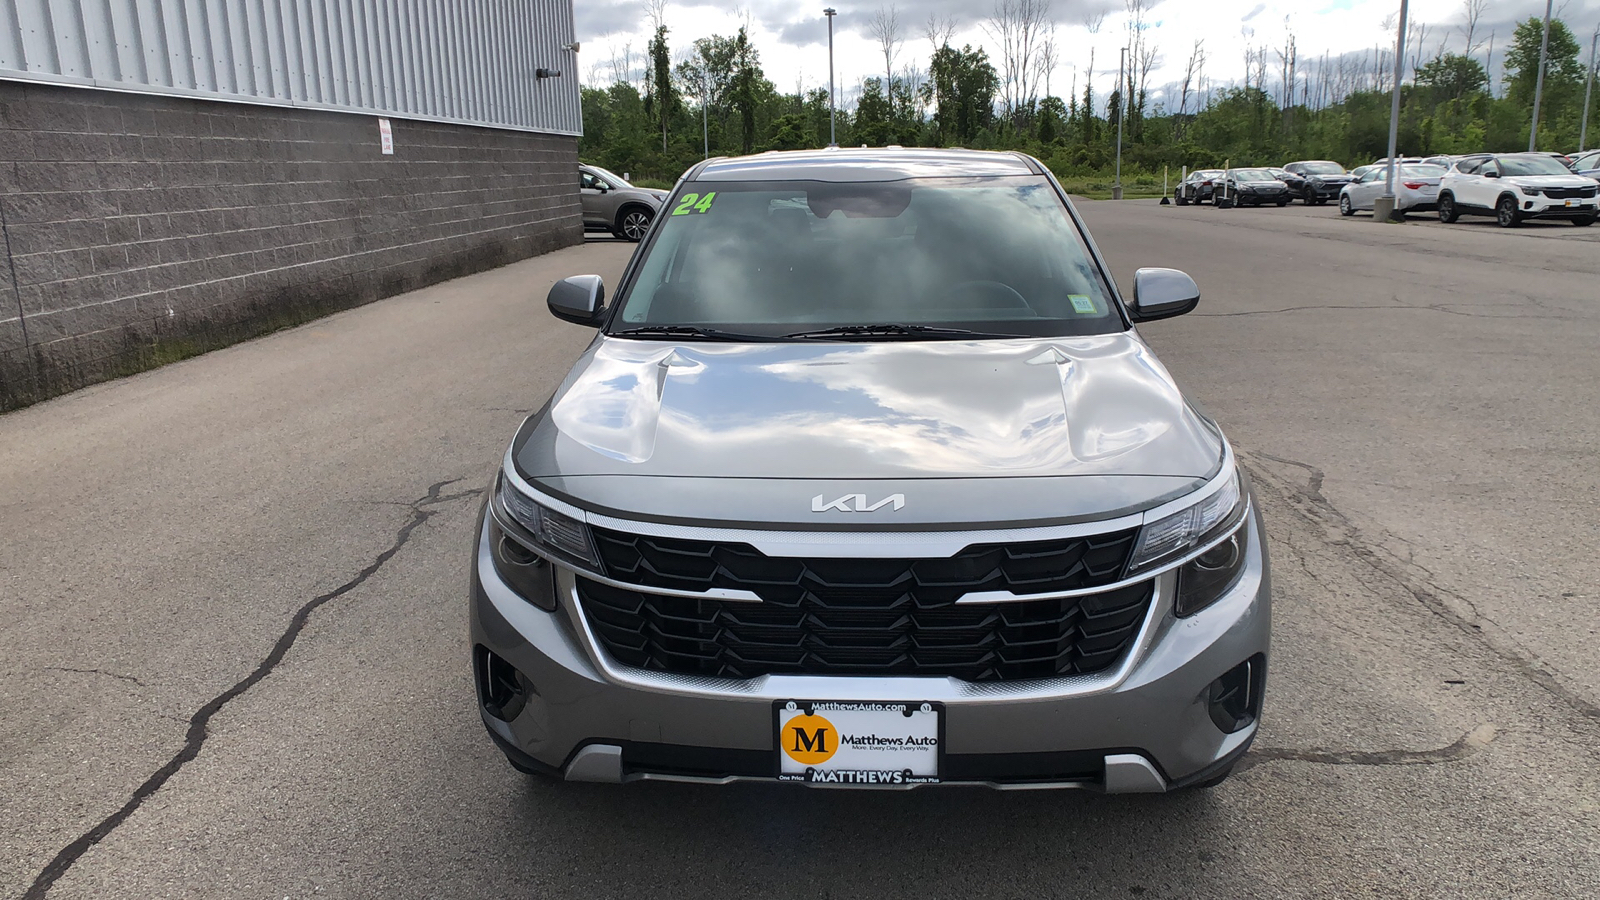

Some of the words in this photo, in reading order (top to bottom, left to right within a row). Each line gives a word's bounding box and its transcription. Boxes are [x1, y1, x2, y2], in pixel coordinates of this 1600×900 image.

[672, 192, 717, 216] 24
[811, 493, 905, 513] KIA
[811, 702, 907, 712] MatthewsAuto.com
[791, 727, 829, 753] M
[841, 734, 903, 746] Matthews
[904, 735, 938, 746] Auto
[811, 770, 903, 784] MATTHEWS
